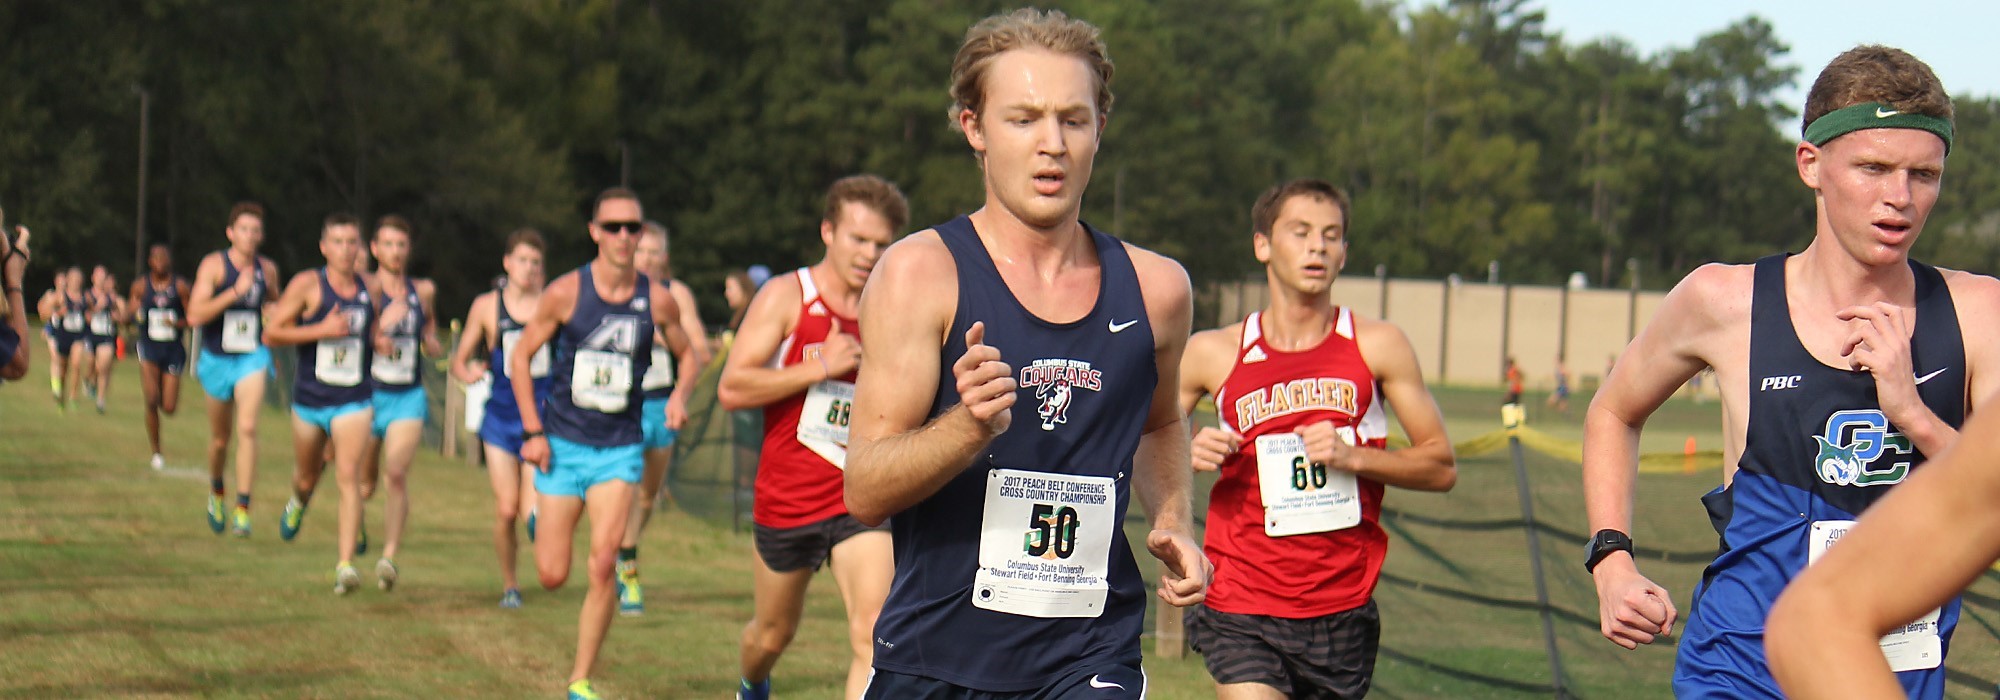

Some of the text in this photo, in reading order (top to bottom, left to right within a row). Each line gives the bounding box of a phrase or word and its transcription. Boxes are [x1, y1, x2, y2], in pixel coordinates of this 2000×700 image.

[1032, 358, 1091, 370] COLUMBUS STATE
[1020, 366, 1102, 392] COUGARS
[1761, 375, 1802, 391] PBC
[1236, 377, 1358, 433] FLAGLER
[1284, 445, 1305, 453] COUNTR
[1824, 409, 1914, 487] GC
[1004, 476, 1105, 494] 2017 PEACH BELT CONFERENCE
[1000, 486, 1107, 505] CROSS COUNTRY CHAMPIONSHIP
[1028, 503, 1077, 559] 50
[990, 567, 1098, 585] Stewart Field Fort Benning Georgia
[1007, 560, 1085, 575] Columbus State University
[1906, 620, 1928, 633] Georgia
